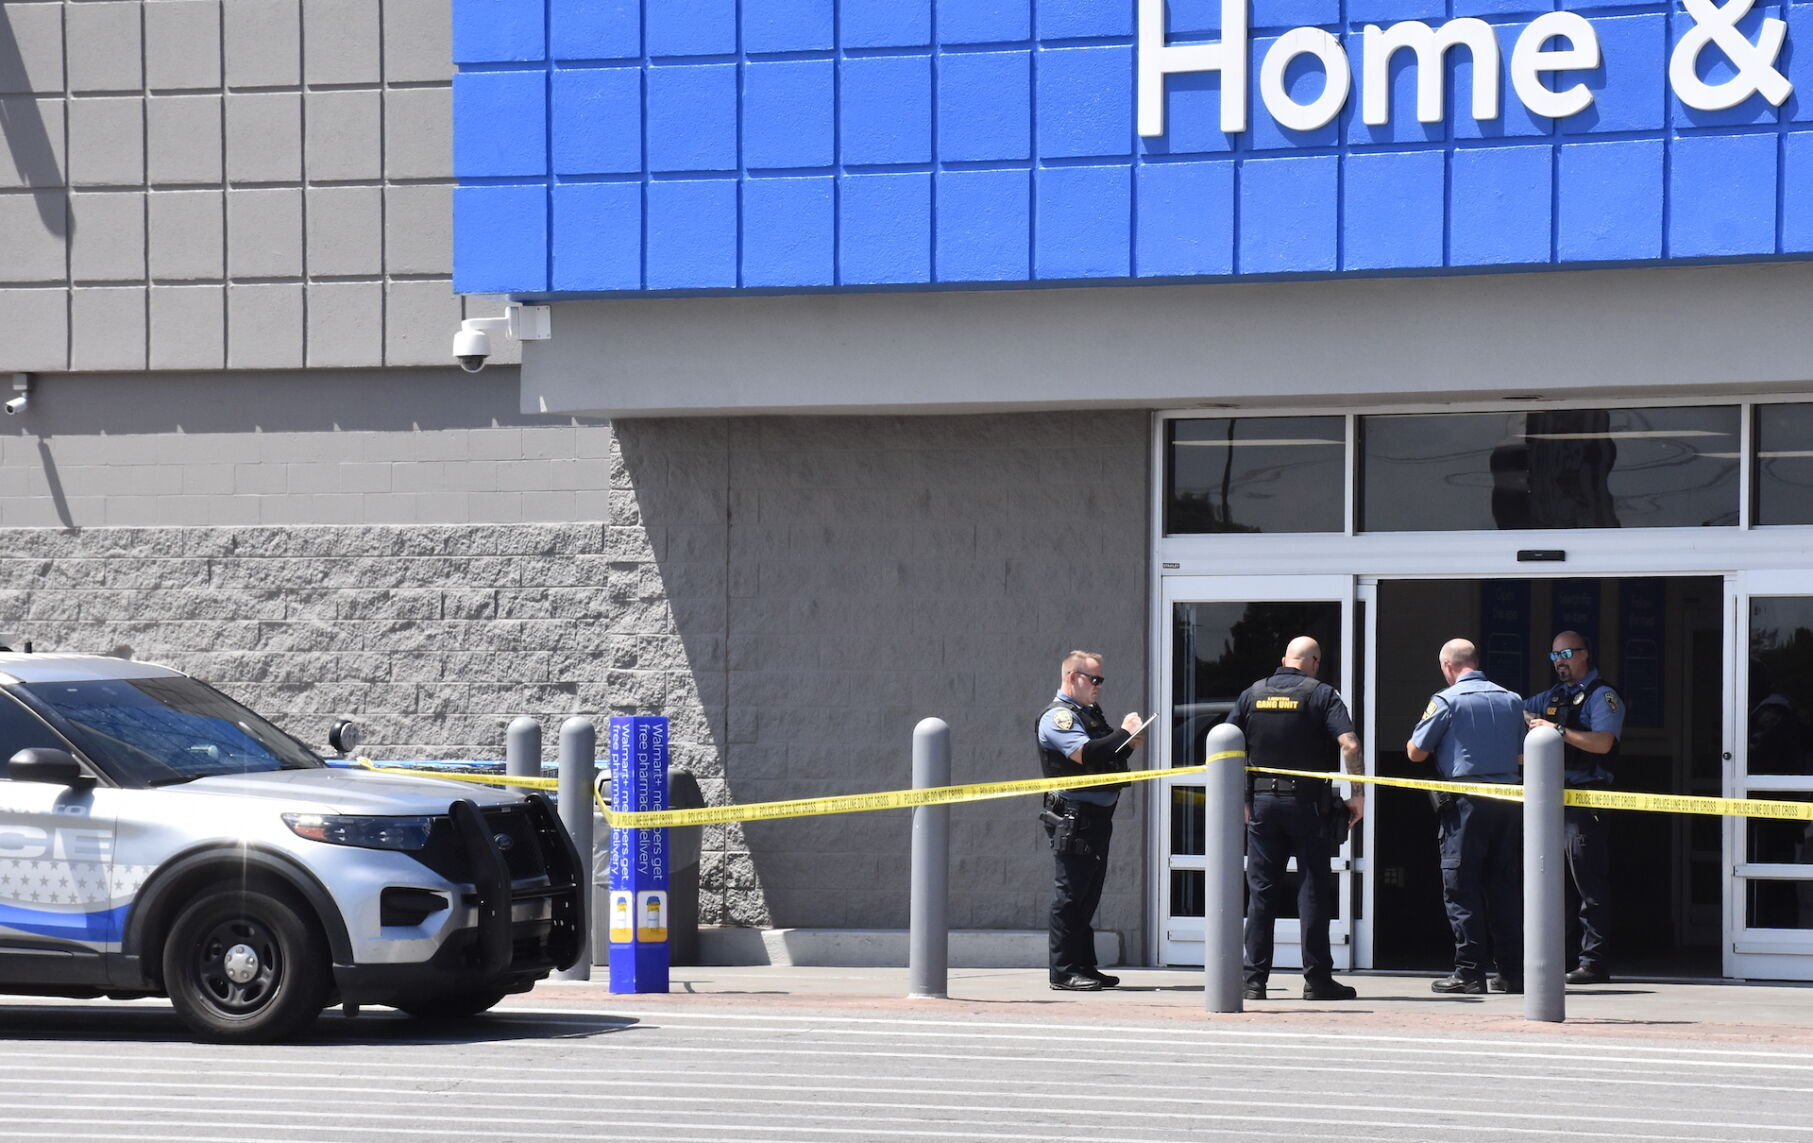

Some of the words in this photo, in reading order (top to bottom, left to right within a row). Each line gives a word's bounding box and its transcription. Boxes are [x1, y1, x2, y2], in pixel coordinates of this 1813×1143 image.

[1138, 0, 1600, 137] Home
[1670, 0, 1793, 111] &
[1256, 700, 1277, 709] GANG
[1278, 700, 1298, 710] UNIT
[612, 724, 621, 750] free
[638, 724, 651, 750] free
[622, 724, 631, 786] Walmart+
[652, 724, 664, 786] Walmart+
[611, 753, 621, 812] pharmac
[637, 753, 650, 812] pharmac
[832, 800, 847, 811] POLICE
[848, 799, 857, 810] LINE
[857, 798, 864, 809] DO
[865, 797, 873, 808] NOT
[874, 796, 889, 807] CROSS
[904, 793, 920, 804] POLICE
[920, 792, 930, 803] LINE
[930, 791, 937, 802] DO
[938, 790, 947, 802] NOT
[948, 788, 964, 801] CROSS
[1575, 793, 1591, 804] POLICE
[1591, 794, 1602, 805] LINE
[1602, 794, 1609, 806] DO
[1610, 795, 1619, 806] NOT
[1621, 795, 1637, 807] CROSS
[1653, 798, 1669, 809] POLICE
[1670, 799, 1681, 810] LINE
[1681, 799, 1689, 810] DO
[1690, 800, 1699, 811] NOT
[1700, 800, 1716, 812] CROSS
[688, 812, 703, 823] POLICE
[704, 811, 713, 822] LINE
[714, 811, 720, 821] DO
[721, 810, 729, 820] NOT
[730, 808, 744, 819] CROSS
[759, 806, 775, 817] POLICE
[775, 805, 784, 816] LINE
[785, 804, 792, 815] DO
[793, 803, 801, 814] NOT
[802, 802, 816, 813] CROSS
[1733, 802, 1750, 814] POLICE
[1751, 803, 1762, 814] LINE
[1763, 803, 1770, 815] DO
[1771, 804, 1780, 815] NOT
[1782, 804, 1798, 816] CROSS
[620, 857, 630, 880] get
[651, 857, 663, 880] get
